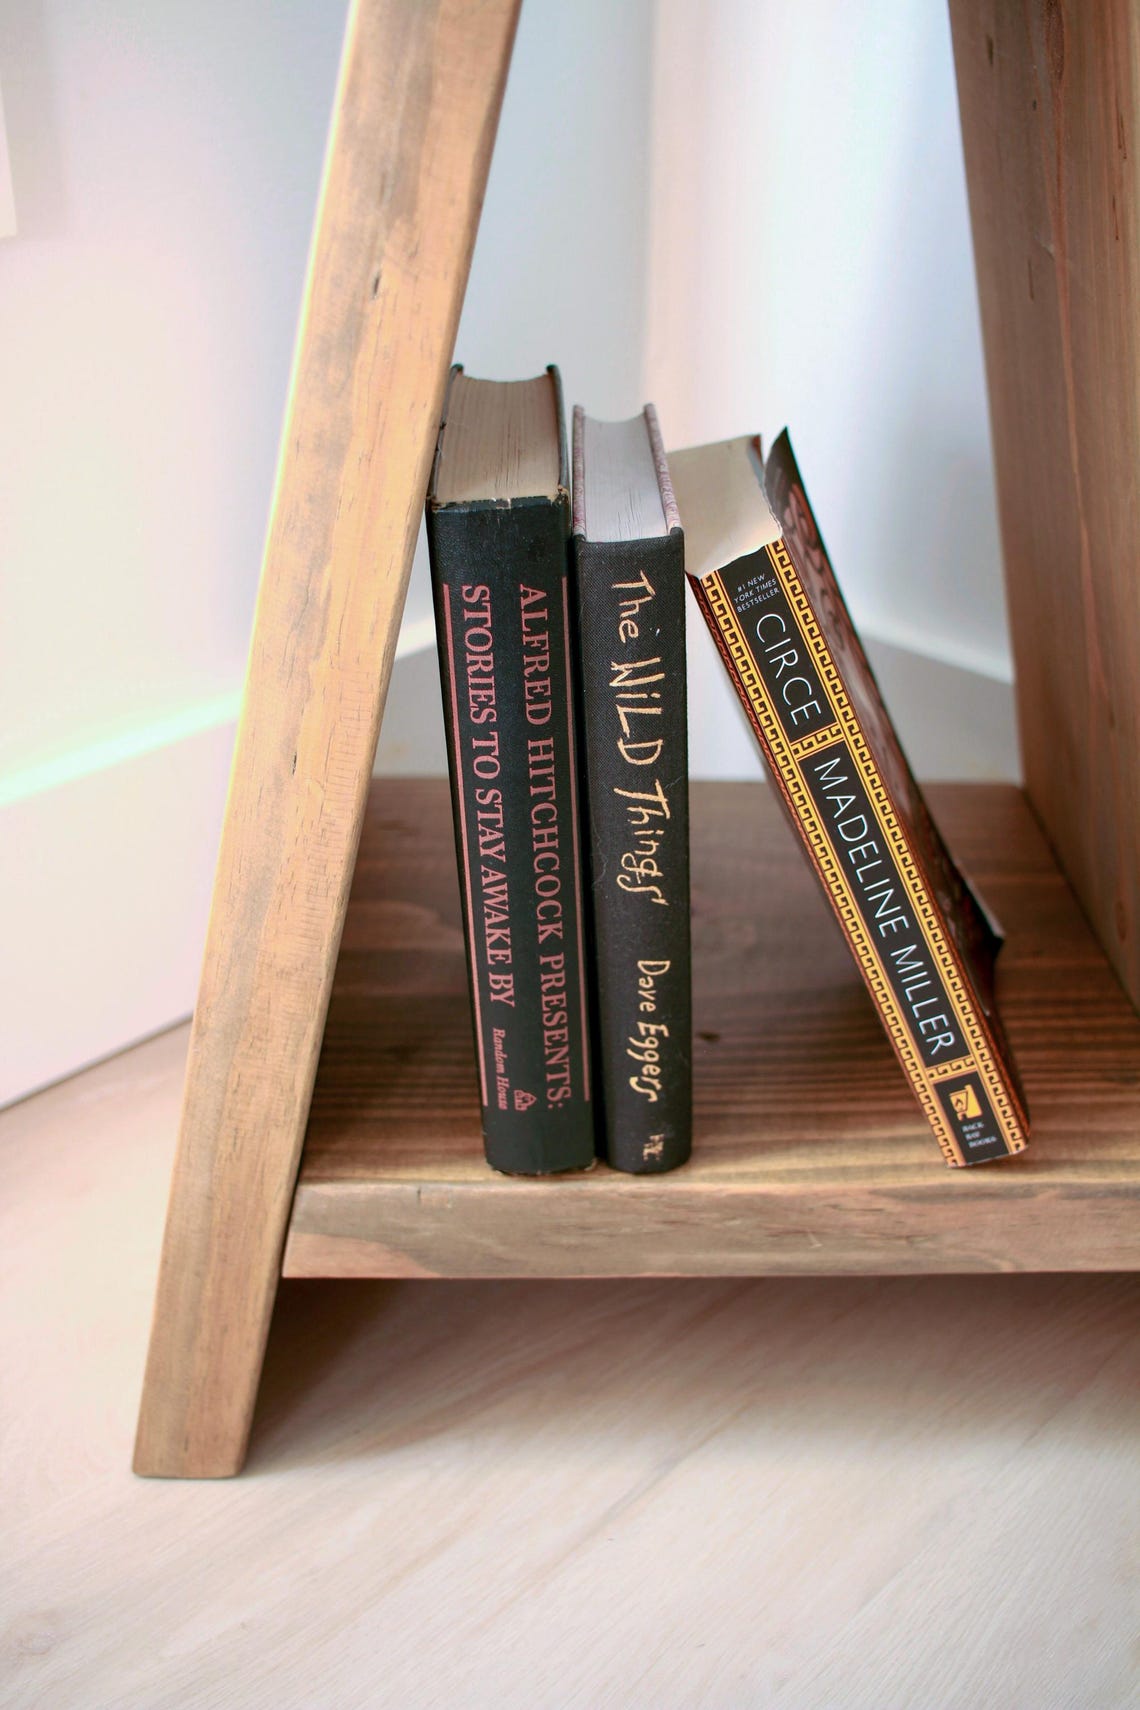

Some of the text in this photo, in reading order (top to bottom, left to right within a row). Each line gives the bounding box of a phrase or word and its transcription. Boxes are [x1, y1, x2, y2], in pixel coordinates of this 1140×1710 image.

[611, 570, 656, 643] The
[733, 578, 777, 604] YORK TIMES
[736, 587, 780, 614] BESTSELLER
[737, 573, 766, 593] #1 NEW
[756, 613, 822, 726] CIRCE
[461, 584, 515, 1007] STORIES TO STAY AWAKE BY
[519, 583, 572, 1109] ALFRED HITCHCOCK PRESENTS:
[613, 778, 671, 906] Things
[814, 757, 955, 1056] MADELINE MILLER
[636, 959, 671, 1013] Dave
[492, 1027, 510, 1110] Random House
[626, 1021, 670, 1103] Eggers
